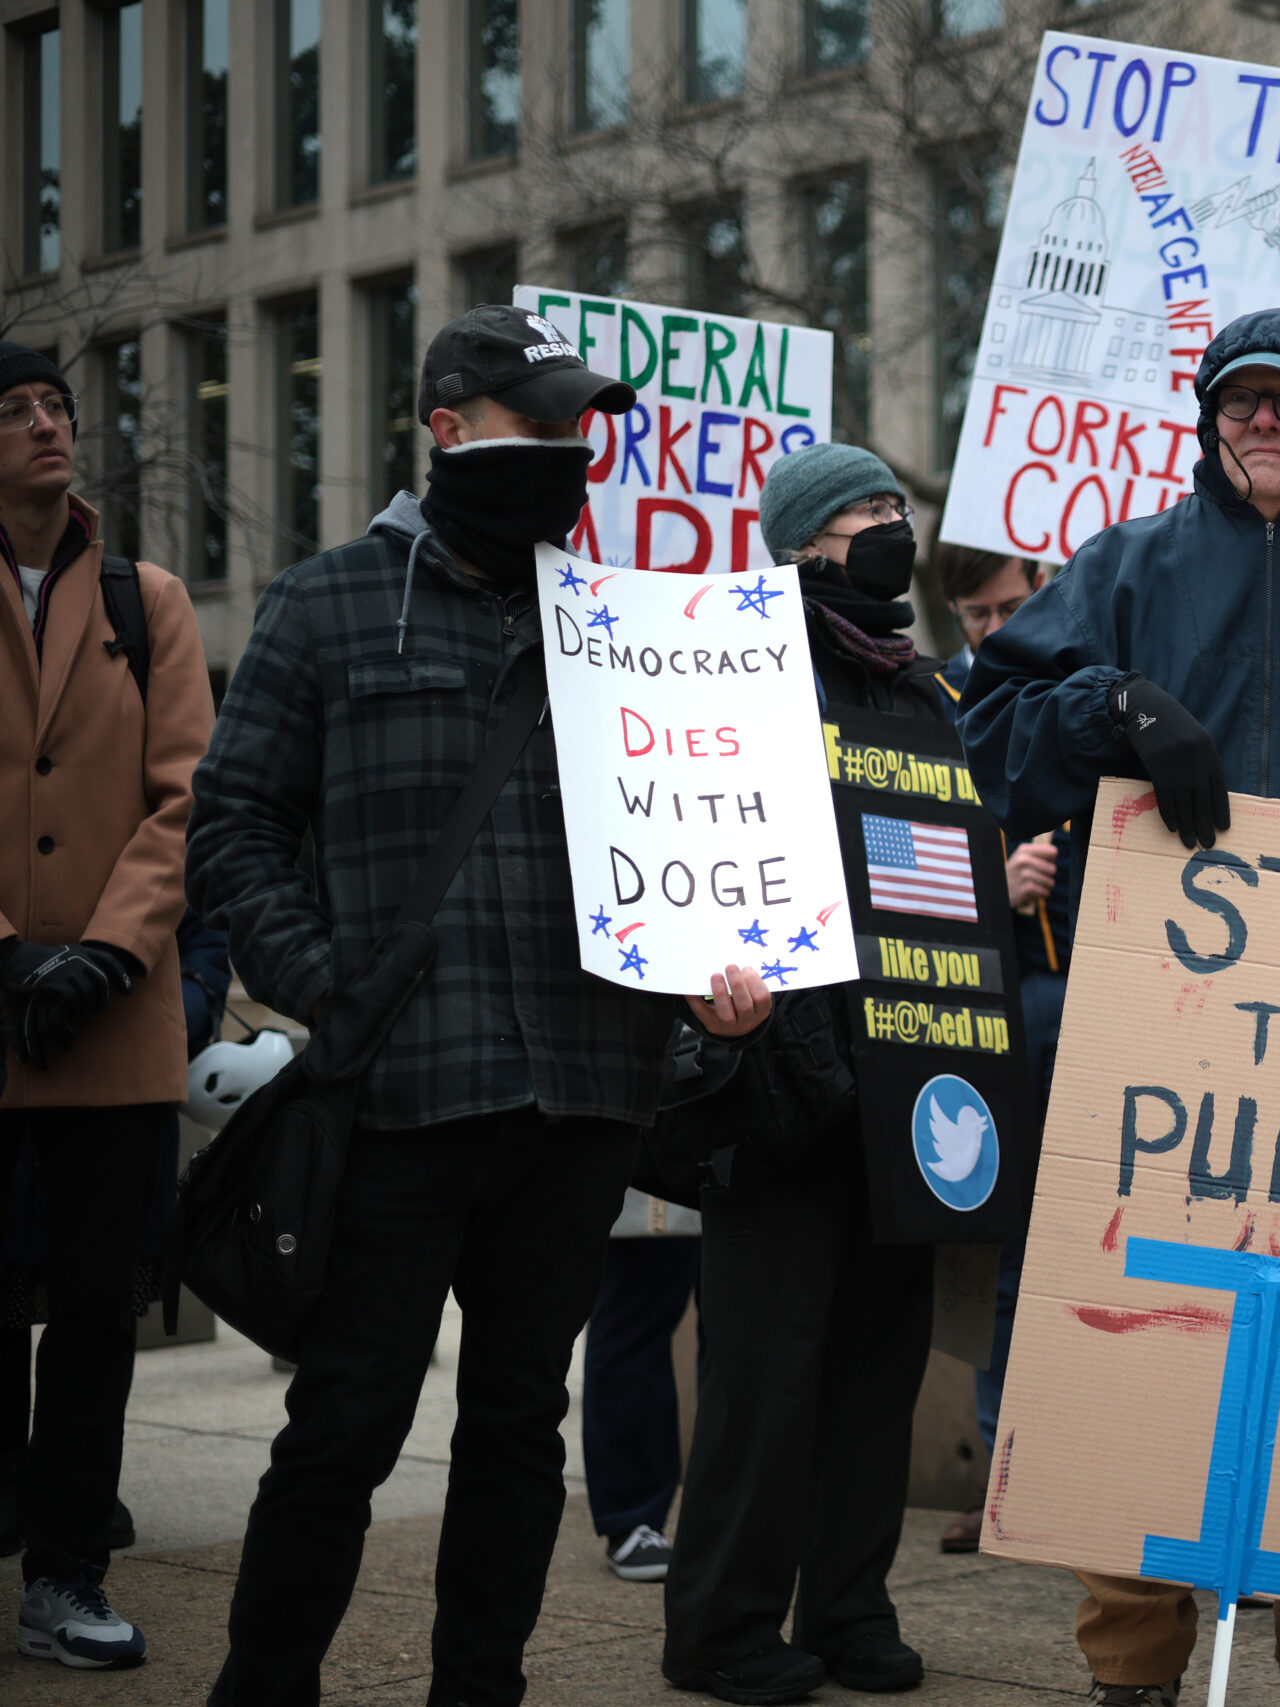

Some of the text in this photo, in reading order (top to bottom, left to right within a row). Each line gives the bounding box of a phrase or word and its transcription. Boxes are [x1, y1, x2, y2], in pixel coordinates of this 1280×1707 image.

[1034, 44, 1197, 143] STOP
[1118, 142, 1168, 194] NTEU
[1139, 192, 1208, 301] AFGE
[580, 402, 816, 499] ORKER
[983, 383, 1205, 485] FORKI
[554, 604, 788, 677] DEMOCRACY
[620, 706, 741, 758] DIES
[617, 776, 767, 824] WITH
[610, 845, 792, 908] DOGE
[878, 937, 981, 988] like you
[975, 1014, 1010, 1055] up
